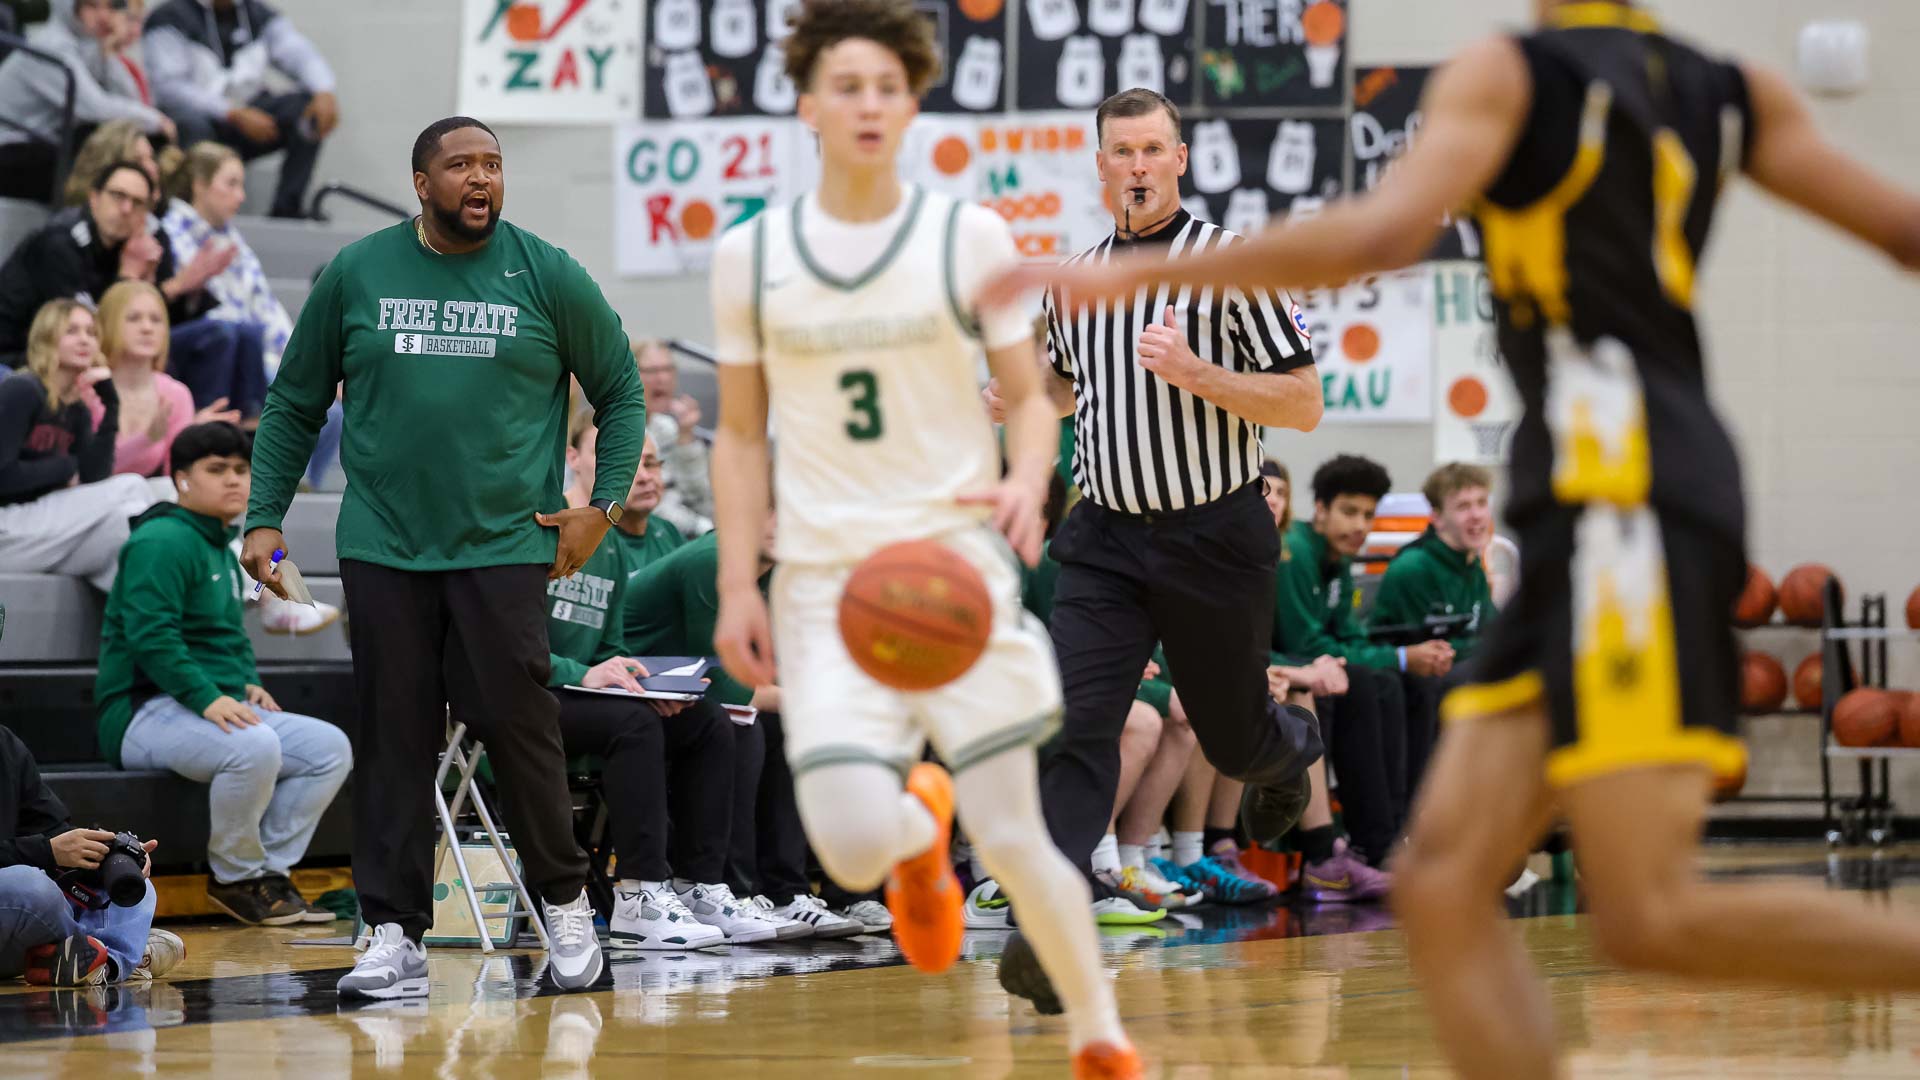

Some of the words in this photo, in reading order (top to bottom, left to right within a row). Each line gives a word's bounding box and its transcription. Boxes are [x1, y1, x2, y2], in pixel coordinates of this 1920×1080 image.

[504, 48, 616, 91] ZAY
[628, 138, 702, 184] GO
[720, 133, 777, 180] 21
[378, 298, 438, 331] FREE
[442, 300, 519, 337] STATE
[426, 338, 490, 355] BASKETBALL
[837, 367, 884, 442] 3
[1322, 366, 1393, 411] EAU
